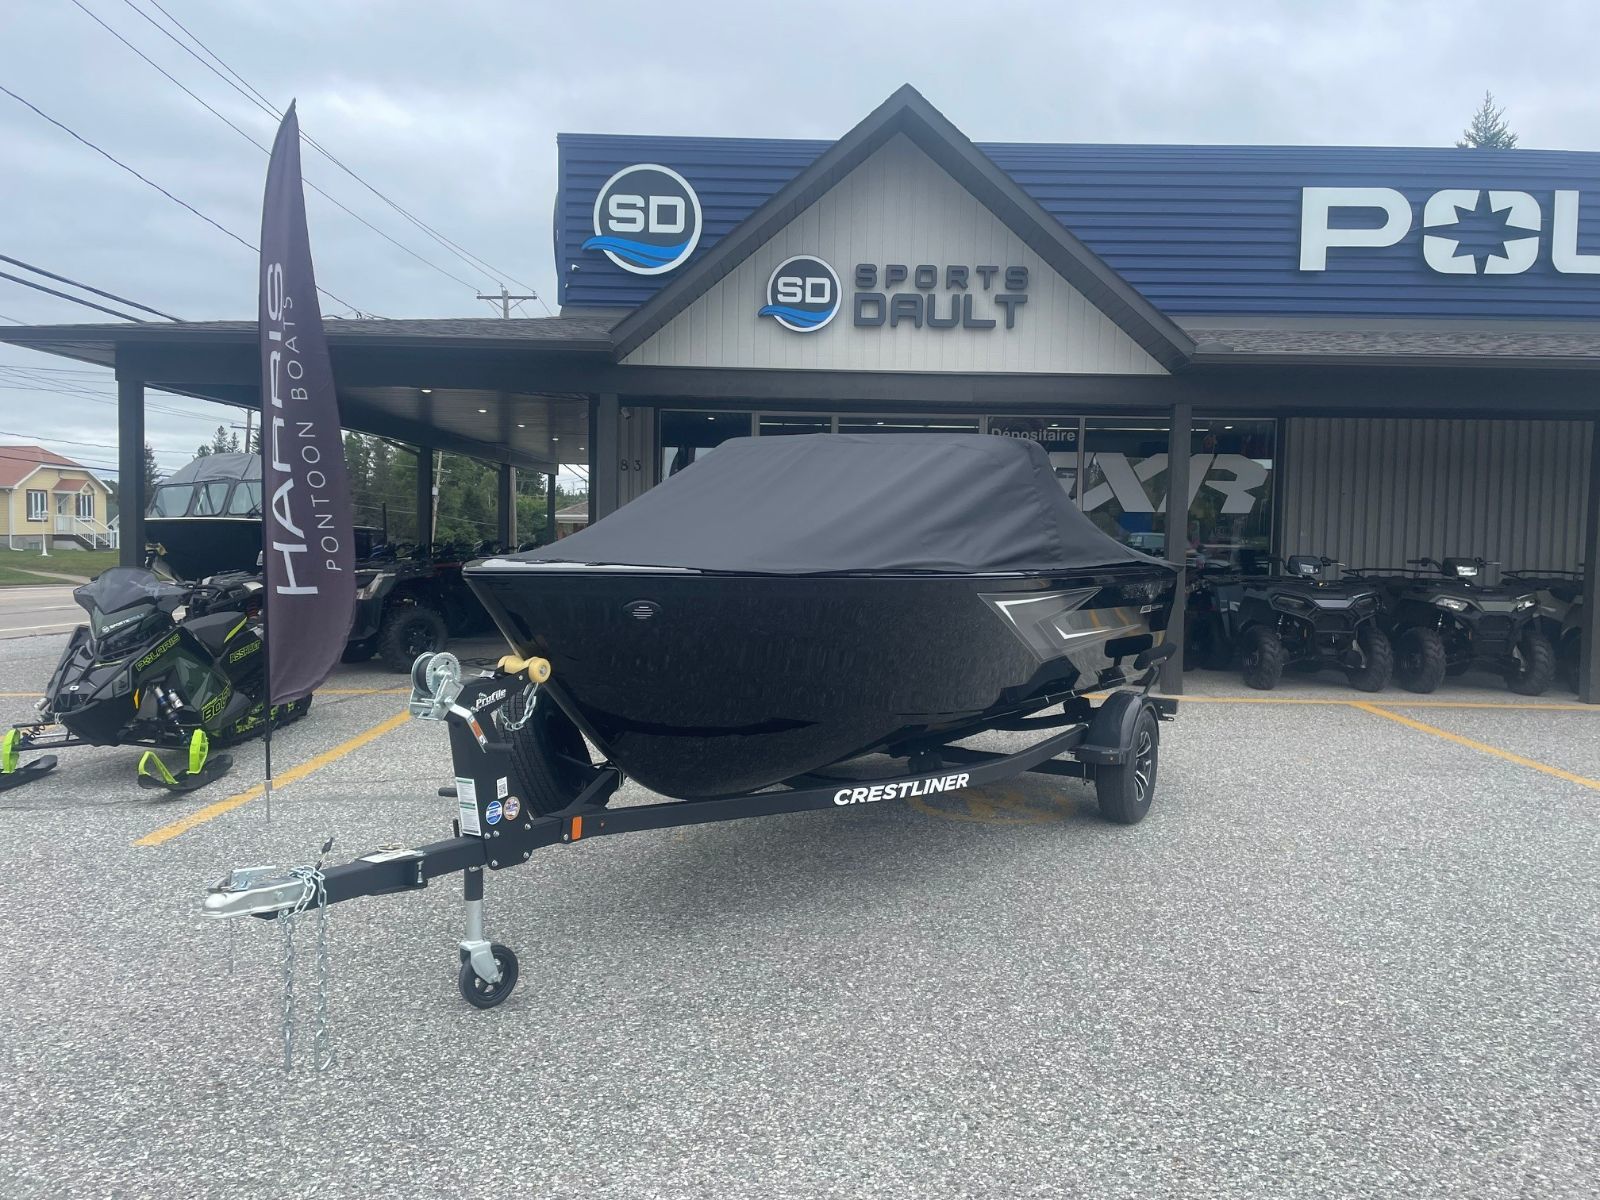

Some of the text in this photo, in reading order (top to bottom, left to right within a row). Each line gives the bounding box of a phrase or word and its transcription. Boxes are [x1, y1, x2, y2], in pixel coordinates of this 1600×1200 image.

[608, 194, 686, 234] SD
[777, 276, 831, 304] SD
[855, 263, 1029, 290] SPORTS
[854, 292, 1029, 329] DAULT
[266, 262, 319, 595] HARRIS
[282, 296, 343, 571] PONTOON BOATS
[135, 633, 181, 672] POLARIS
[475, 689, 507, 709] Profile
[833, 772, 970, 806] CRESTLINER
